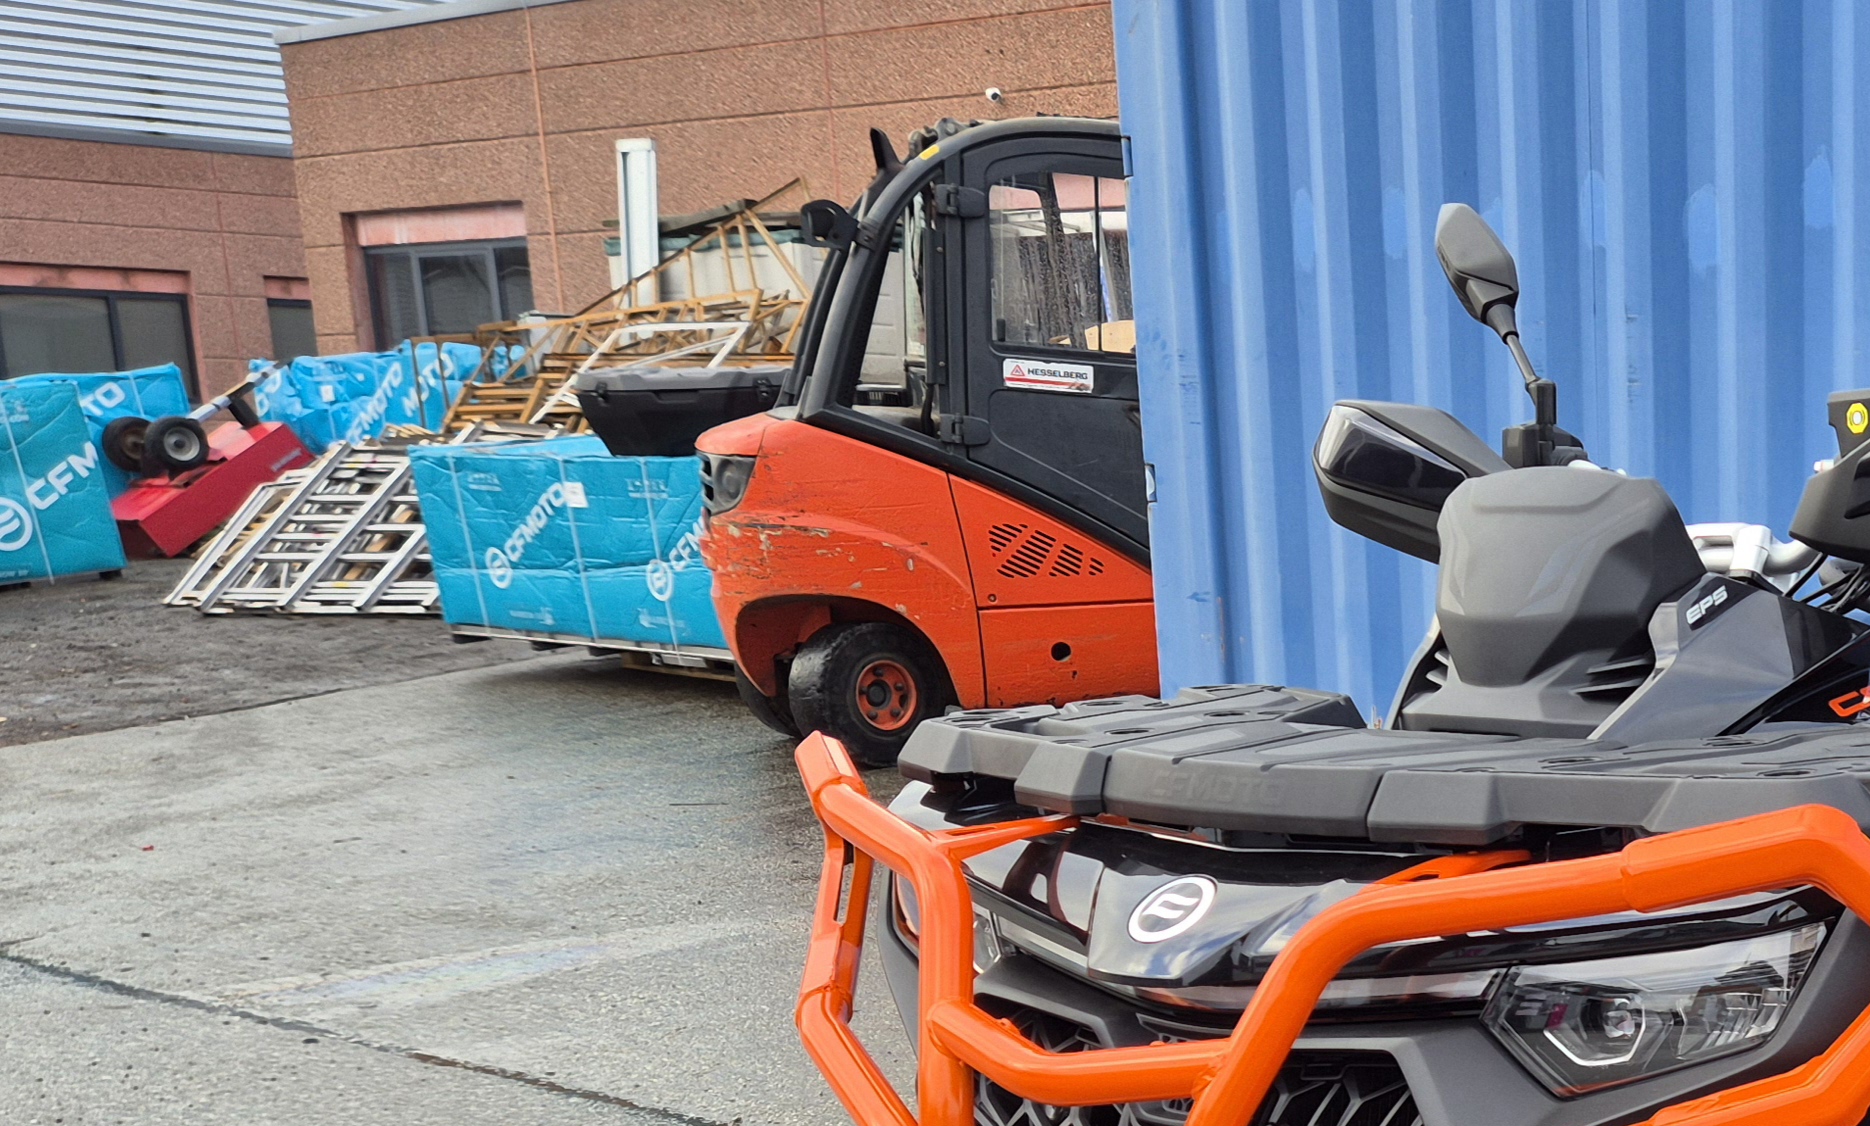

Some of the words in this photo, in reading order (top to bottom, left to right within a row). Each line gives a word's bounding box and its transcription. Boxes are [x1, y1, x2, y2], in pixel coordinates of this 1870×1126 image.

[1027, 368, 1088, 380] HESSELBERG
[503, 482, 564, 562] CFMOTO
[1686, 585, 1728, 625] EPS
